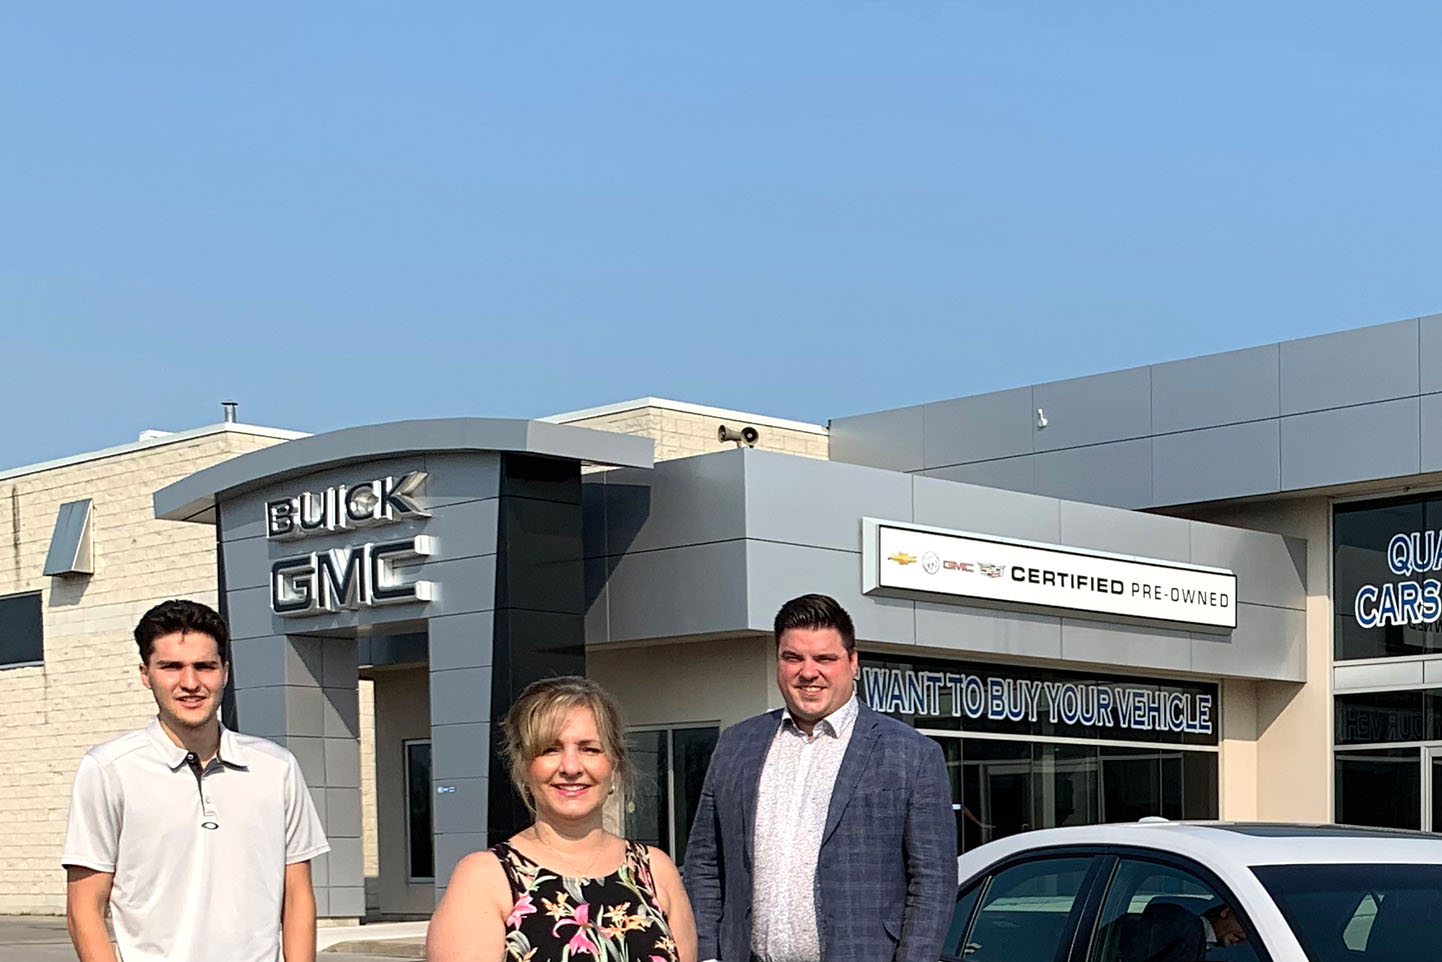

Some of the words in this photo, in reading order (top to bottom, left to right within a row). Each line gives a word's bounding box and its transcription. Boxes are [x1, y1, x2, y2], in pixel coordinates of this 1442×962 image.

[265, 471, 432, 540] BUICK
[270, 535, 432, 616] GMC
[943, 560, 975, 573] GMC
[1011, 566, 1124, 595] CERTIFIED
[1131, 582, 1229, 608] PRE-OWNED
[1354, 578, 1442, 628] CARS
[863, 667, 945, 716] WANT
[946, 673, 984, 719] TO
[987, 677, 1042, 722] BUY
[1044, 681, 1114, 728] YOUR
[1114, 687, 1212, 735] VEHICLE
